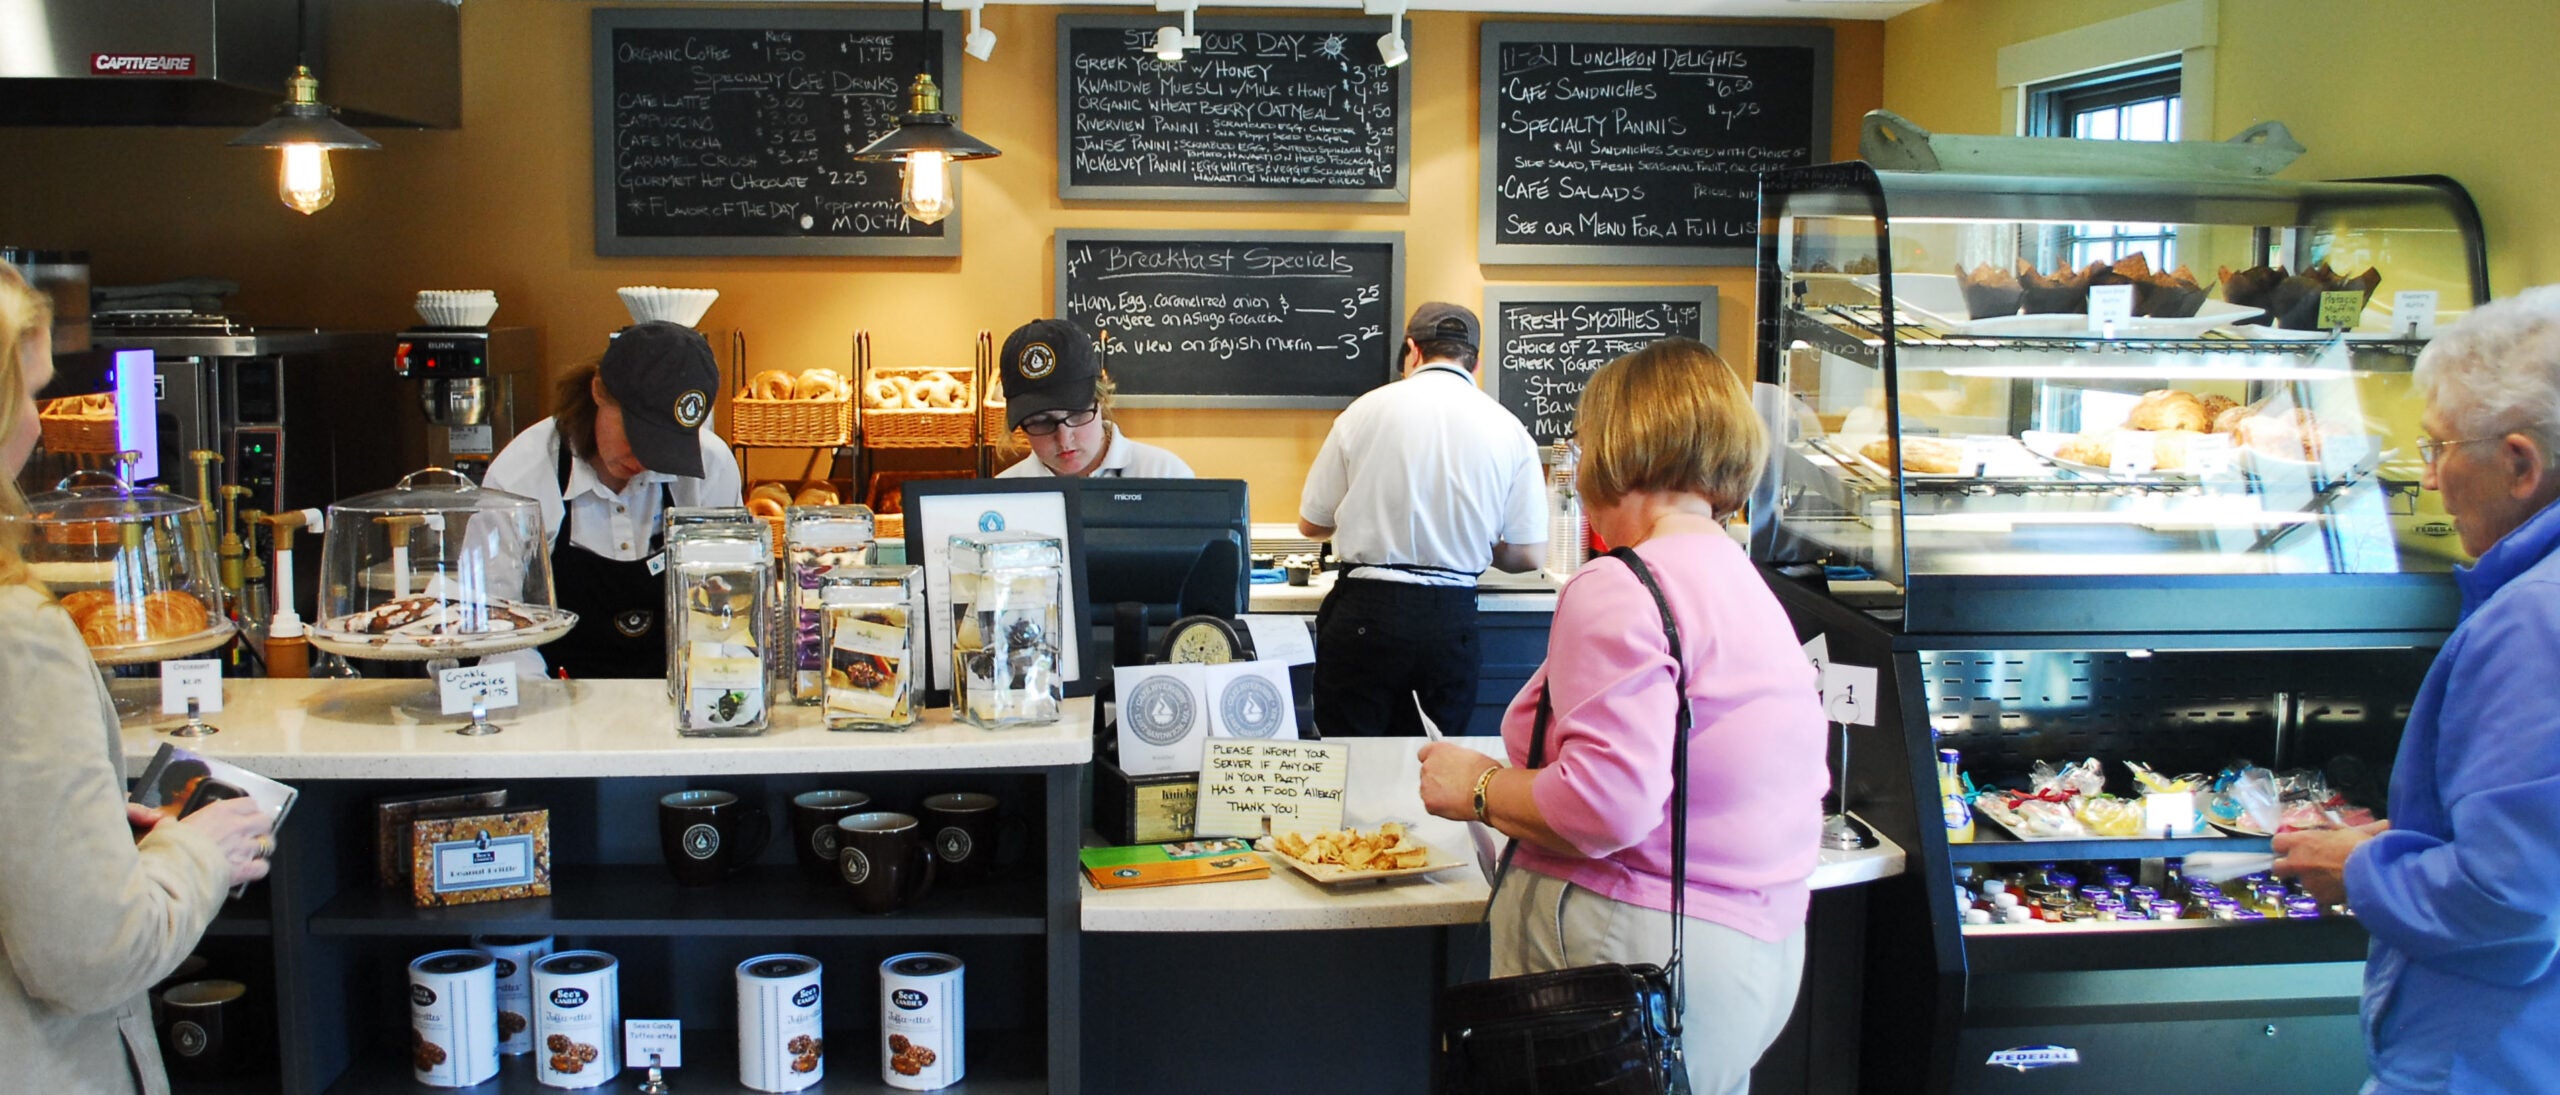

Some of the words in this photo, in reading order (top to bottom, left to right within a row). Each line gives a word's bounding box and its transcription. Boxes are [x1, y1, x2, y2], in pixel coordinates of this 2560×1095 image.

[1257, 32, 1306, 62] DAY
[1571, 44, 1655, 68] LUNCHEON
[1664, 48, 1747, 69] DELIGHTS
[1075, 53, 1128, 75] GREEK
[1131, 56, 1187, 78] YOGURT
[1216, 60, 1272, 82] HONEY
[833, 71, 899, 93] DRINKS
[1077, 76, 1151, 95] KWANDWE
[1160, 76, 1223, 96] MUESLI
[1297, 83, 1337, 106] HONEY
[1554, 78, 1657, 100] SANDWICHES
[1078, 95, 1142, 113] ORGANIC
[1148, 97, 1197, 114] WHEAT
[1200, 101, 1255, 122] BERRY
[1258, 101, 1340, 121] OATMEAL
[1076, 113, 1145, 132] RIVERVIEW
[1509, 110, 1607, 140] SPECIALTY
[1615, 108, 1686, 135] PANINIS
[1076, 135, 1127, 151] JANSE
[1590, 160, 1634, 172] FRESH
[1559, 177, 1645, 201] SALADS
[736, 201, 767, 218] THE
[770, 201, 800, 219] DAY
[832, 213, 911, 234] MOCHA
[1505, 214, 1537, 235] SEE
[1545, 220, 1575, 236] OUR
[1579, 212, 1626, 237] MENU
[1632, 214, 1663, 237] FOR
[1666, 221, 1677, 236] A
[1104, 247, 1235, 272] Breakfast
[1243, 248, 1354, 275] Specials
[1233, 297, 1270, 309] onion
[1095, 314, 1155, 330] Gruyere
[1161, 315, 1181, 327] on
[1505, 306, 1568, 330] FRESH
[1571, 305, 1660, 331] SMOOTHIES
[1181, 340, 1206, 352] on
[1506, 339, 1555, 355] CHOICE
[1560, 340, 1582, 355] OF
[1586, 340, 1602, 354] 2
[1503, 355, 1555, 371] GREEK
[1846, 684, 1854, 705] 1
[1213, 745, 1255, 756] PLEASE
[1262, 746, 1297, 757] INFORM
[1304, 748, 1330, 759] YOUR
[1213, 759, 1253, 769] SERVER
[1261, 760, 1271, 770] IF
[1224, 772, 1235, 782] IN
[1239, 772, 1266, 783] YOUR
[1275, 773, 1309, 787] PARTY
[1211, 786, 1236, 796] HAS
[1263, 786, 1298, 797] FOOD
[1226, 801, 1267, 814] THANK
[1271, 802, 1299, 819] YOU!
